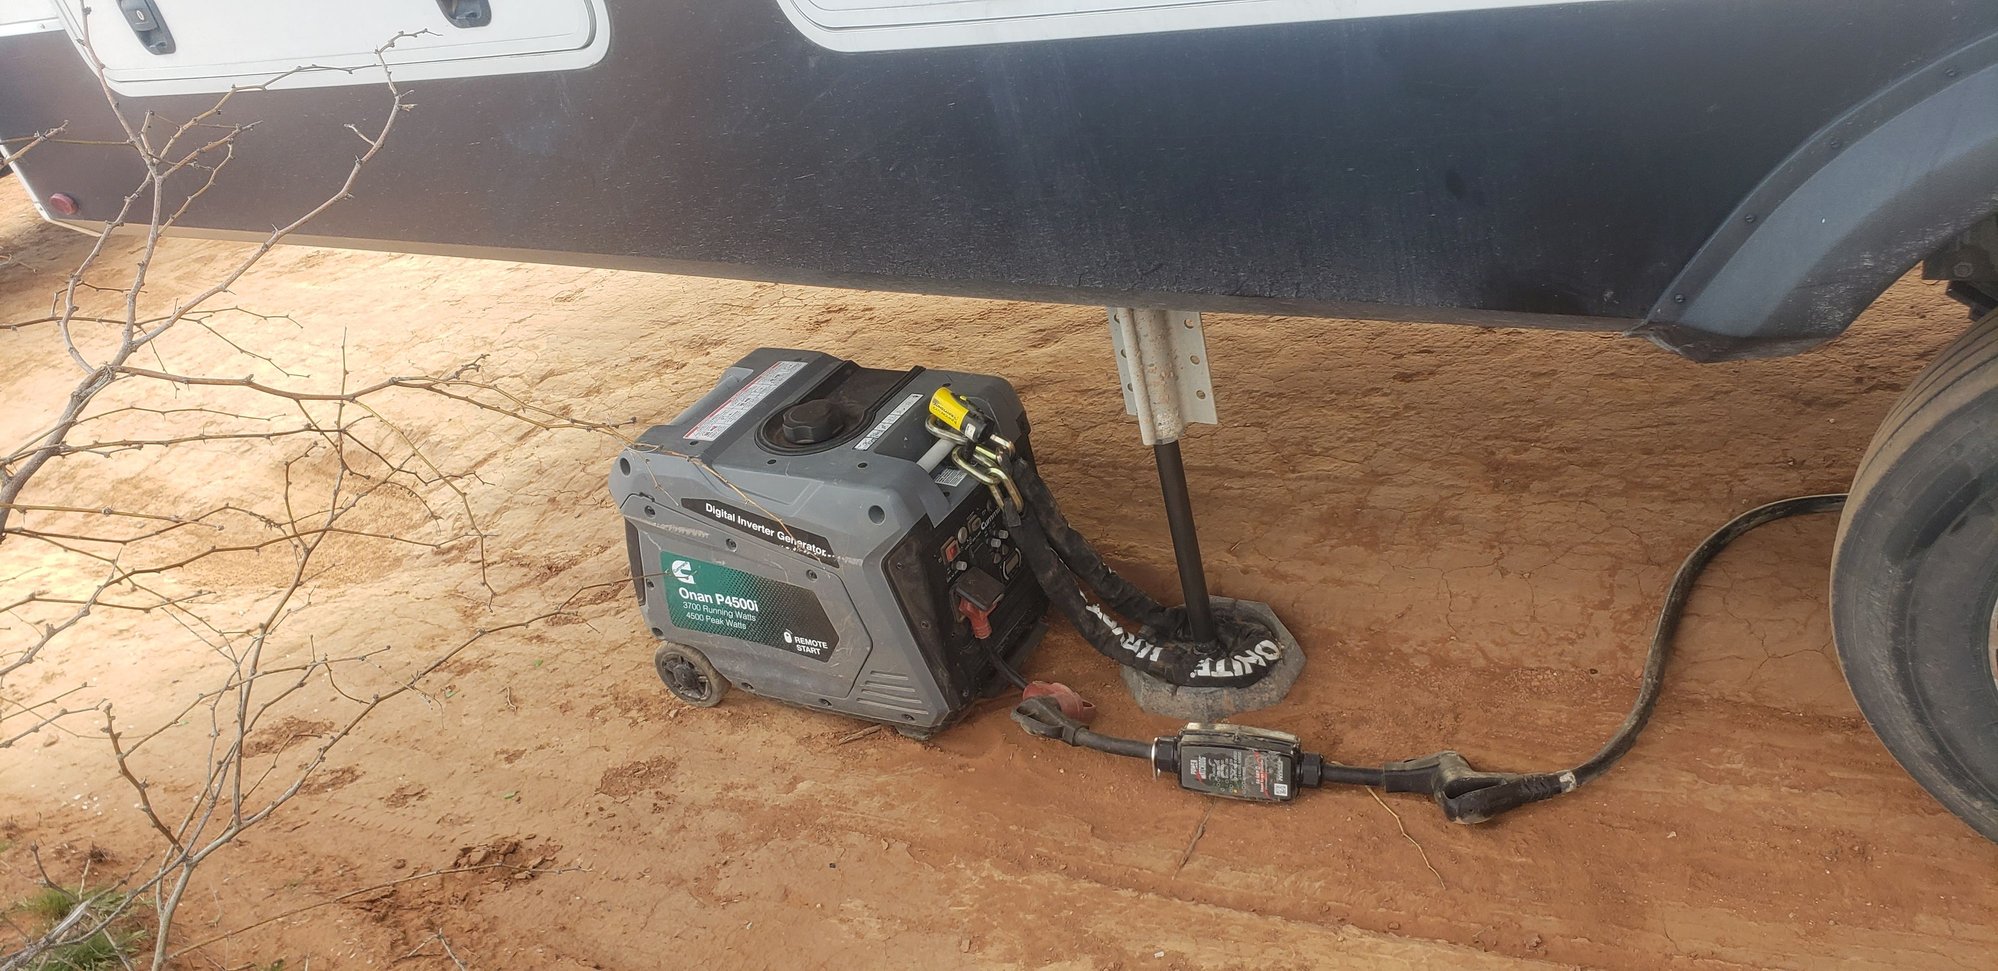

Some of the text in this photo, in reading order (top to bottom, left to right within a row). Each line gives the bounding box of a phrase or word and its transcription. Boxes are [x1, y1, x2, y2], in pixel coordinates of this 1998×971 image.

[705, 502, 827, 557] Digital Inverter Generator
[678, 587, 759, 612] Onan P4500i
[683, 601, 757, 622] 3700 Running Watts
[686, 612, 747, 630] 4500 Peak Watts
[794, 636, 828, 650] REMOTE
[796, 644, 821, 655] START
